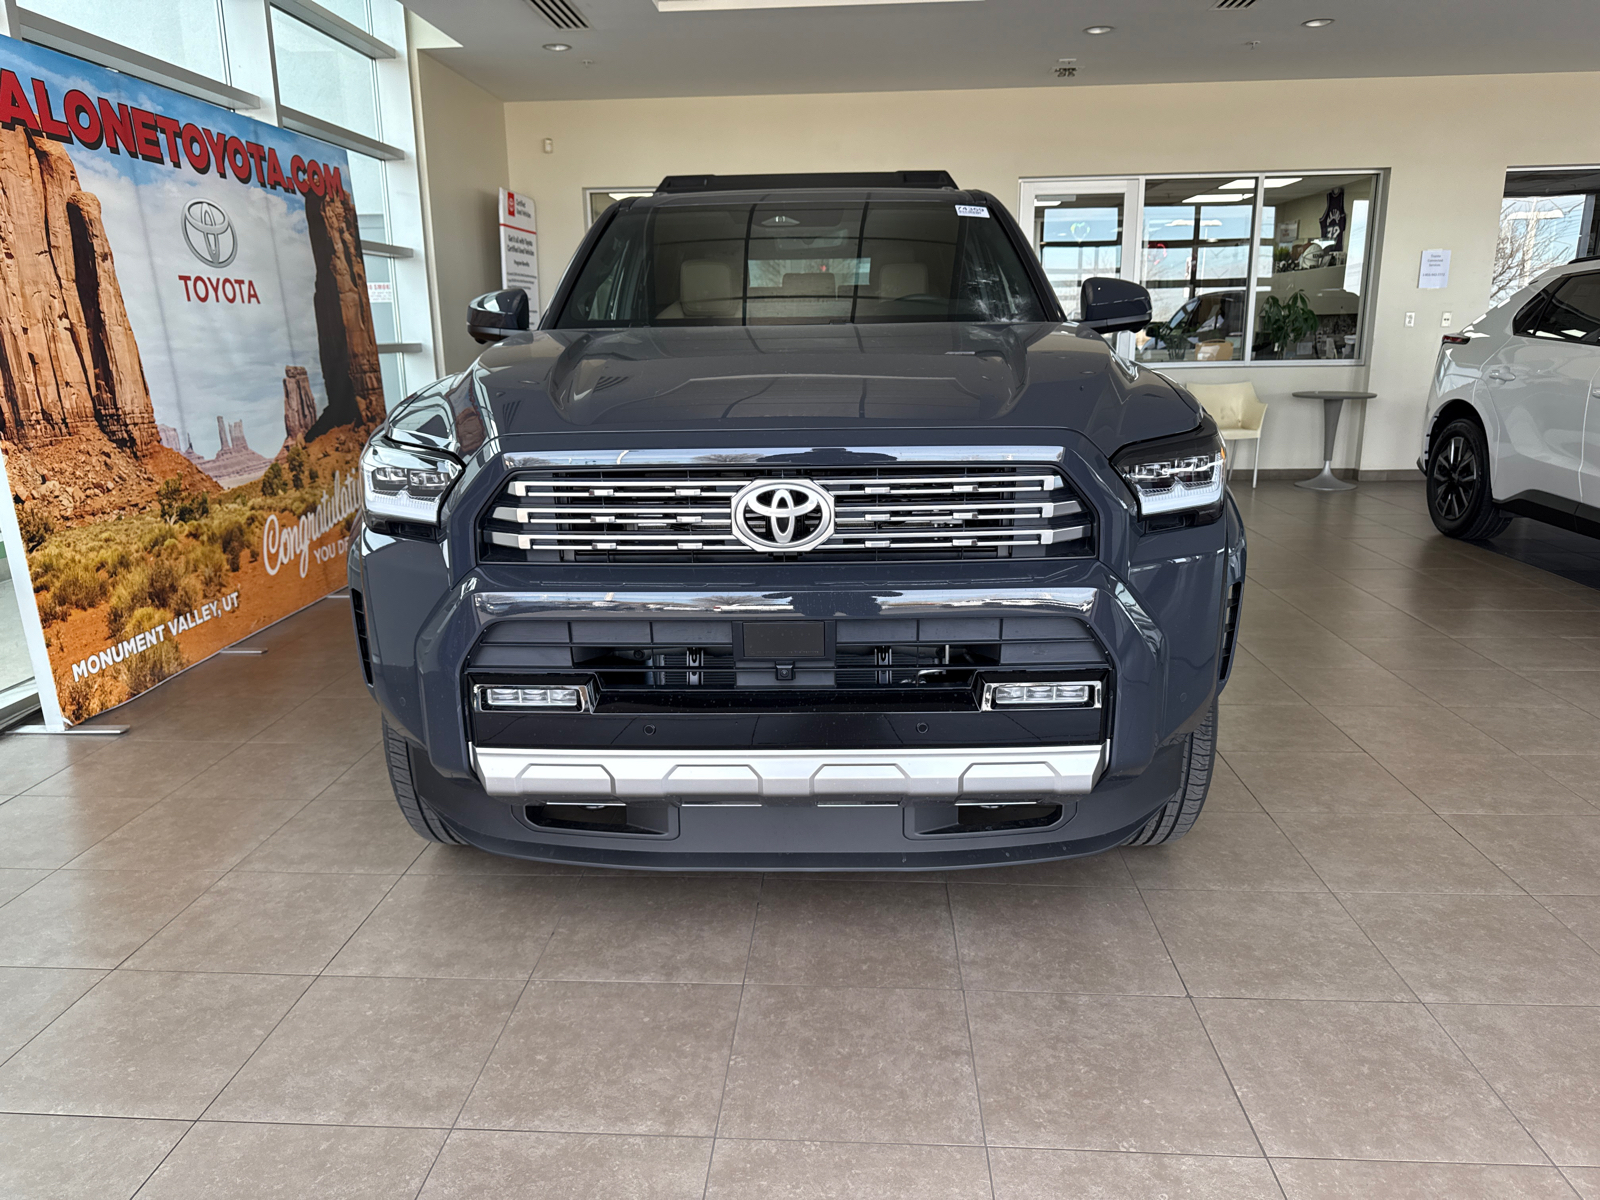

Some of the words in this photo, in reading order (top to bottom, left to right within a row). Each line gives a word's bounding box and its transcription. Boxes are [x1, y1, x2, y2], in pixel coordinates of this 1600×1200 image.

[178, 275, 261, 304] TOYOTA
[313, 543, 336, 564] YOU
[71, 624, 165, 682] MONUMENT
[167, 601, 222, 636] VALLEY,
[222, 592, 239, 611] UT
